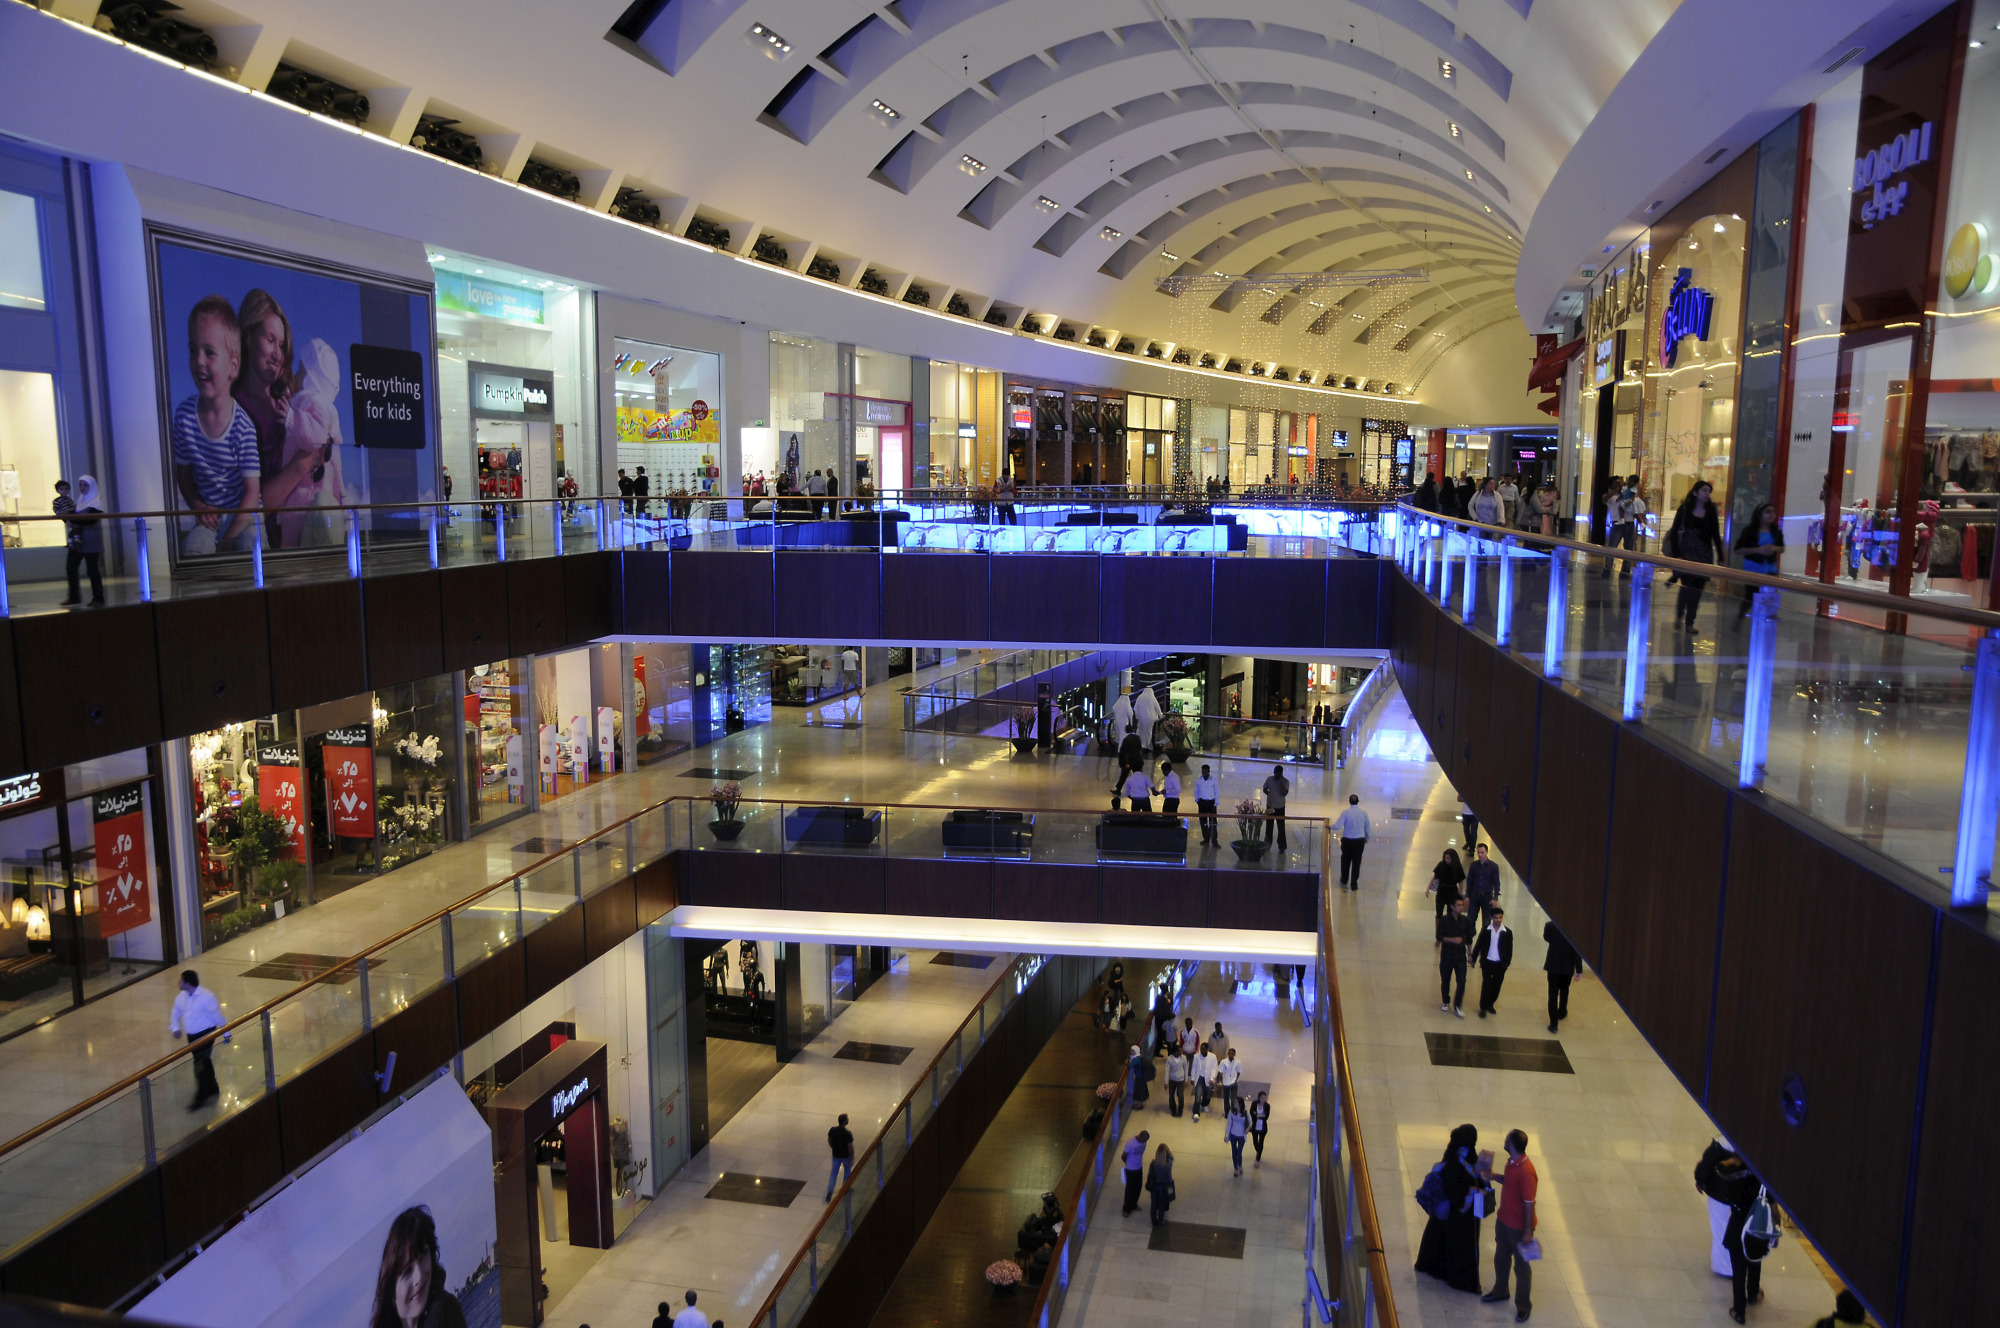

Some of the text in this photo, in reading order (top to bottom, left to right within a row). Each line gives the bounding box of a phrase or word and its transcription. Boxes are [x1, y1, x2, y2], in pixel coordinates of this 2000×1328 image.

[1852, 121, 1932, 192] BOBOLI
[1945, 253, 1975, 277] BOBOL
[467, 281, 494, 305] love
[503, 294, 517, 304] new
[503, 304, 541, 319] generation!
[354, 372, 422, 400] Everything
[484, 384, 548, 405] Pumpkin Patch
[366, 400, 412, 421] for kids
[326, 729, 367, 744] تنزيلات
[262, 748, 300, 764] نزيلات
[342, 778, 354, 788] إلى
[98, 789, 139, 814] تنزيلات
[281, 800, 292, 811] إلى
[118, 856, 128, 869] إلى
[117, 900, 136, 915] خصم
